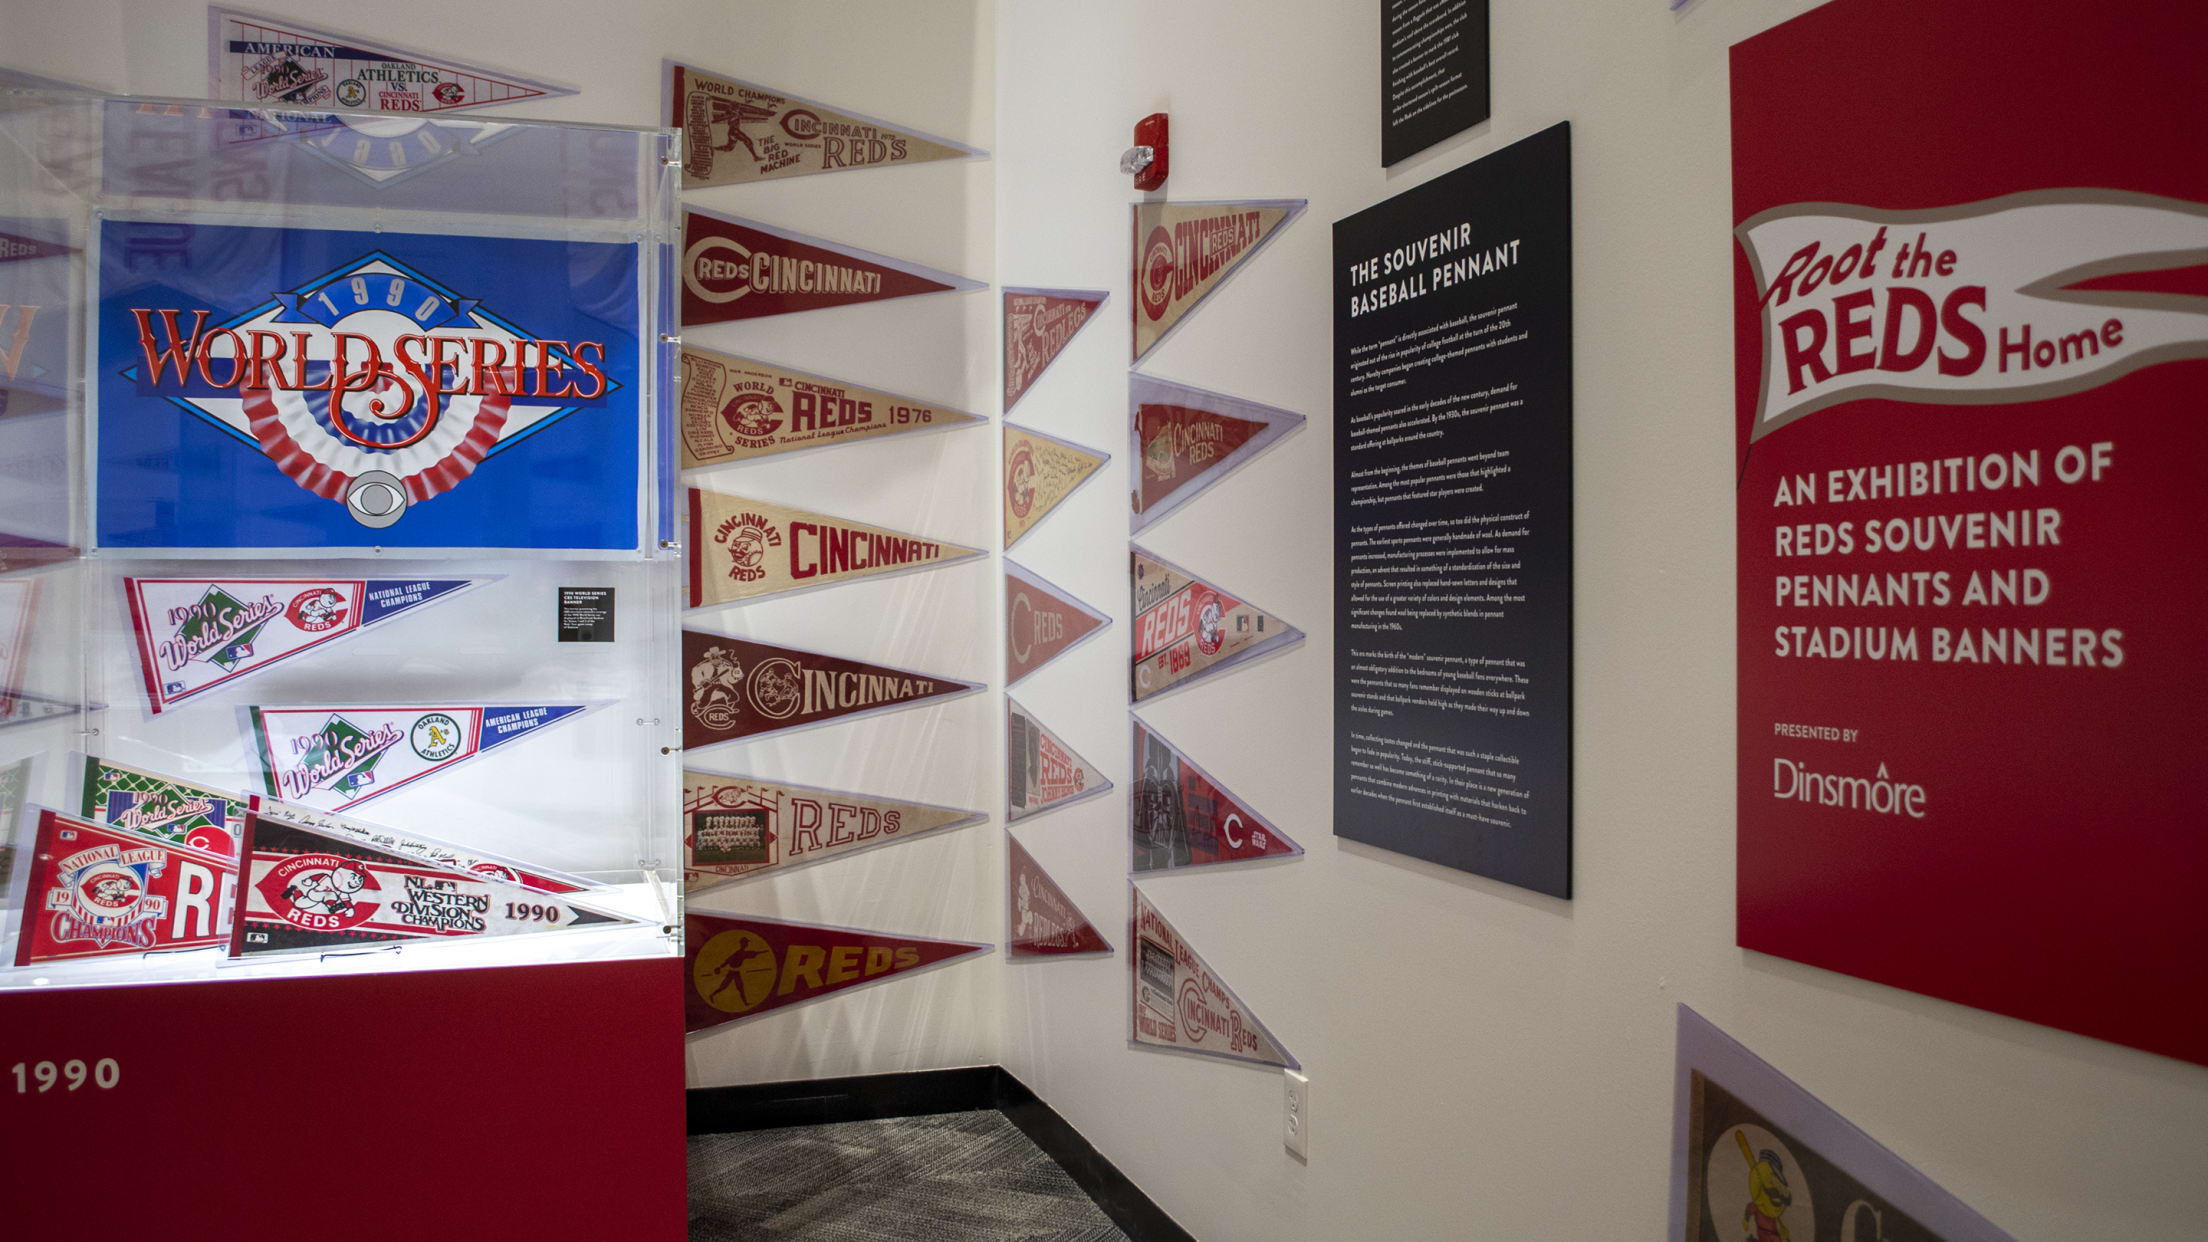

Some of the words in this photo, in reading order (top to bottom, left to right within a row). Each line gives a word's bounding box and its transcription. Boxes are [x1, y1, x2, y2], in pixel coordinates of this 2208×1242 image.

[244, 42, 336, 59] AMERICAN
[357, 68, 439, 84] ATHLETICS
[381, 62, 416, 70] OAKLAND
[253, 75, 290, 99] World
[290, 68, 322, 89] Series
[378, 91, 419, 99] CINCINNATI
[695, 78, 734, 96] WORLD
[738, 89, 786, 104] CHAMPIONS
[380, 98, 420, 111] REDS
[779, 109, 878, 140] CINCINNATI
[758, 135, 775, 147] THE
[764, 144, 780, 154] BIG
[822, 136, 907, 169] REDS
[760, 154, 801, 174] MACHINE
[768, 149, 788, 162] RED
[1212, 229, 1234, 255] REDS
[1350, 257, 1379, 287] THE
[1384, 222, 1471, 275] SOUVENIR
[1174, 211, 1260, 301] CINCINNATI
[1760, 225, 1888, 307] Root
[1891, 232, 1957, 279] the
[699, 260, 750, 280] REDS
[750, 252, 881, 294] CINCINNATI
[1351, 273, 1427, 318] BASEBALL
[1433, 239, 1520, 291] PENNANT
[317, 276, 439, 321] 1990
[1041, 303, 1087, 366] REDLEGS
[1778, 285, 1987, 396] REDS
[1999, 318, 2124, 374] Home
[130, 308, 379, 392] WORLD
[733, 381, 775, 395] WORLD
[794, 381, 845, 398] CINCINNATI
[791, 390, 872, 433] REDS
[889, 405, 932, 424] 1976
[735, 435, 775, 448] SERIES
[736, 425, 763, 435] REDS
[779, 432, 815, 444] National
[817, 429, 844, 441] League
[845, 422, 887, 435] Champions
[1173, 417, 1223, 457] CINCINNATI
[1189, 440, 1215, 465] REDS
[1773, 472, 1816, 508] AN
[1828, 449, 2040, 502] EXHIBITION
[2054, 441, 2113, 485] OF
[714, 513, 782, 548] CINCINNATI
[1775, 521, 1855, 557] REDS
[1864, 507, 2061, 554] SOUVENIR
[790, 521, 940, 579] CINCINNATI
[728, 565, 766, 582] REDS
[368, 587, 403, 601] NATIONAL
[405, 582, 431, 593] LEAGUE
[1775, 570, 1951, 607] PENNANTS
[1962, 568, 2050, 606] AND
[168, 601, 217, 625] 1990
[380, 593, 423, 608] CHAMPIONS
[160, 621, 222, 671] World
[219, 595, 272, 640] Series
[304, 621, 332, 631] REDS
[1034, 609, 1063, 645] REDS
[1140, 589, 1192, 658] REDS
[1774, 625, 1919, 661] STADIUM
[1931, 627, 2125, 668] BANNERS
[1169, 645, 1192, 675] 1869
[746, 657, 934, 719] CINCINNATI
[418, 717, 450, 730] OAKLAND
[485, 713, 521, 728] AMERICAN
[522, 707, 547, 719] LEAGUE
[497, 718, 539, 734] CHAMPIONS
[709, 712, 730, 721] REDS
[290, 730, 339, 755] 1990
[1774, 723, 1840, 740] PRESENTED
[1842, 728, 1858, 743] BY
[283, 750, 344, 799] World
[340, 723, 393, 769] Series
[421, 743, 455, 758] ATHLETICS
[1040, 733, 1073, 767] CINCINNATI
[1040, 752, 1073, 785] REDS
[133, 791, 168, 805] 1990
[121, 805, 167, 831] World
[167, 798, 208, 820] Series
[789, 798, 901, 856] REDS
[63, 846, 118, 871] NATIONAL
[121, 850, 164, 865] LEAGUE
[278, 857, 340, 877] CINCINNATI
[715, 865, 750, 874] CINCINNATI
[55, 891, 69, 902] 19
[145, 898, 160, 909] 90
[94, 897, 119, 908] REDS
[392, 902, 472, 921] DIVISION
[409, 889, 490, 913] WESTERN
[505, 902, 559, 923] 1990
[52, 911, 156, 948] CHAMPIONS
[287, 909, 341, 928] REDS
[402, 914, 487, 932] CHAMPIONS
[1141, 901, 1174, 951] NATIONAL
[1175, 939, 1200, 978] LEAGUE
[1202, 971, 1230, 1009] CHAMPS
[777, 944, 920, 997] REDS
[1177, 978, 1230, 1043] CINCINNATI
[1231, 1009, 1258, 1053] REDS
[12, 1057, 120, 1094] 1990
